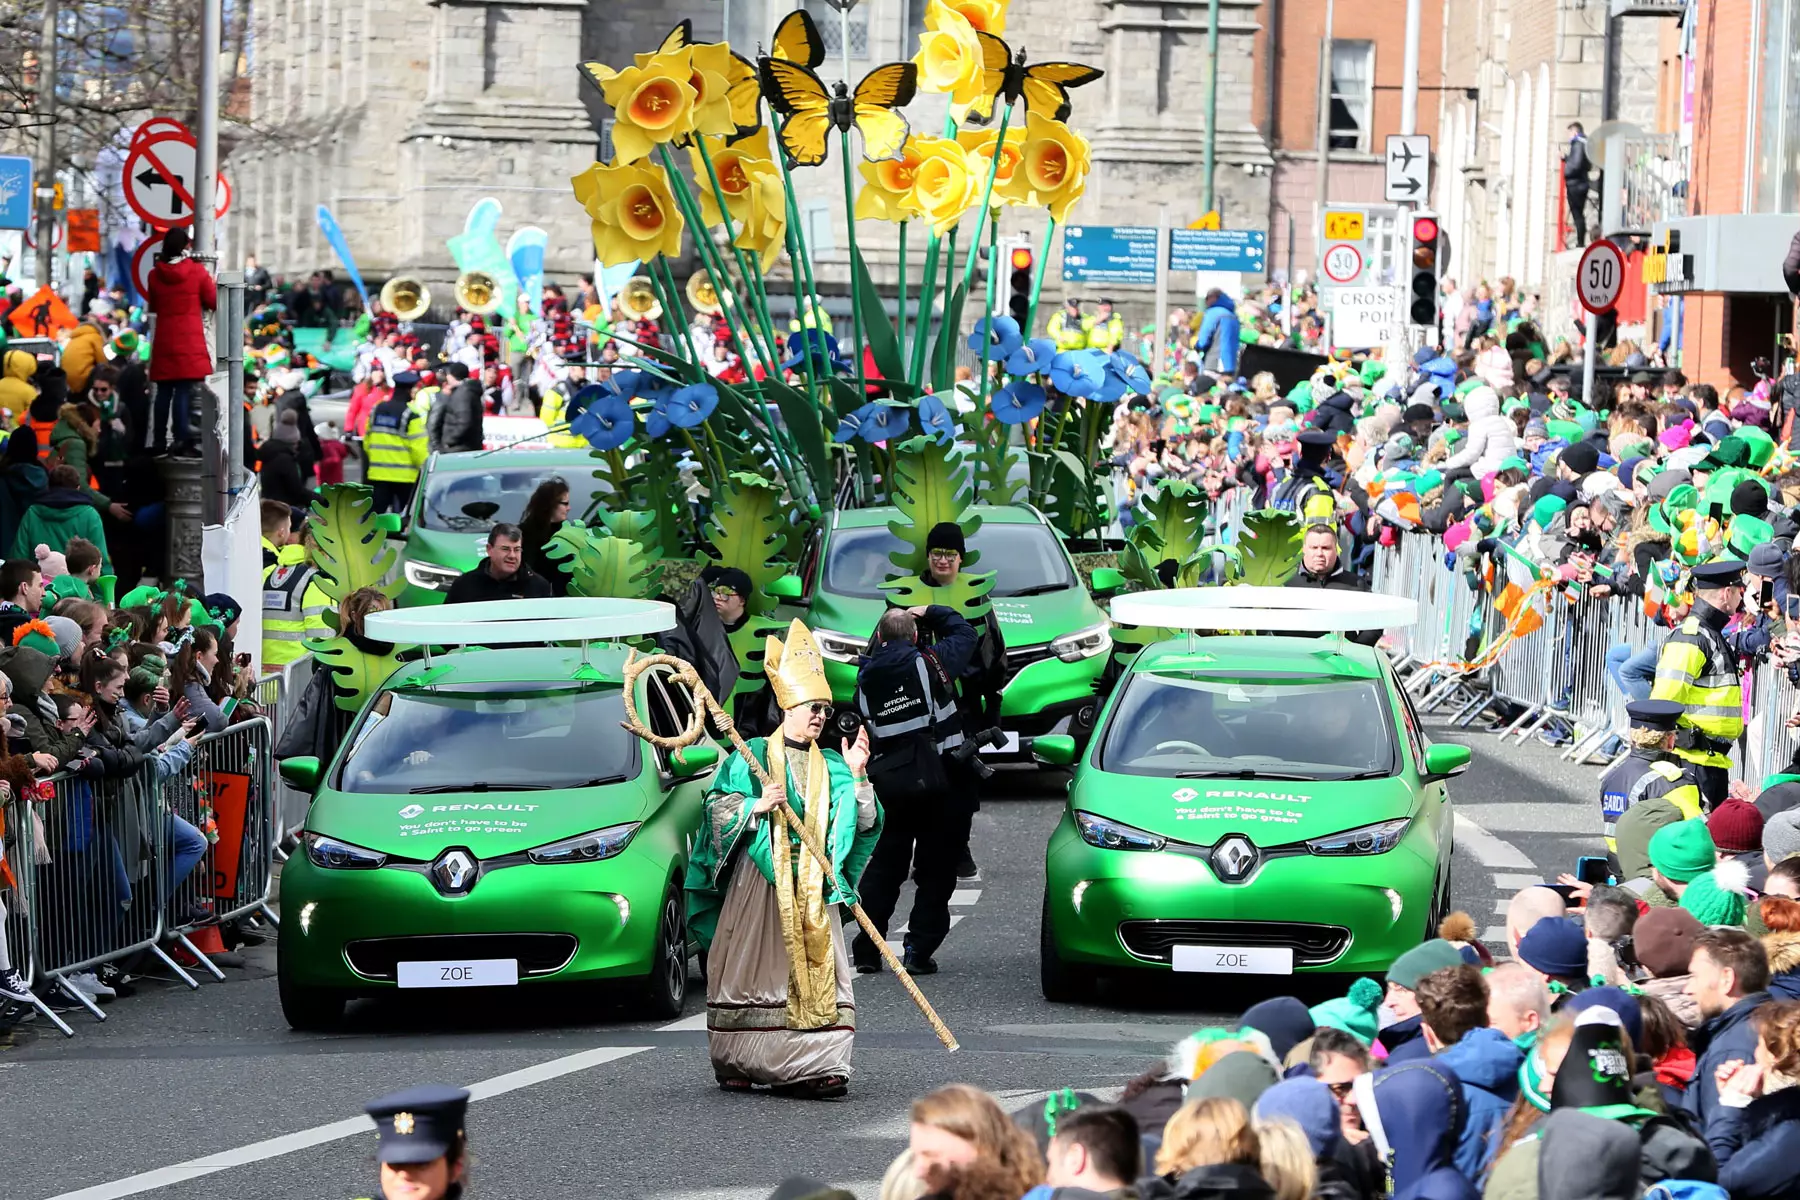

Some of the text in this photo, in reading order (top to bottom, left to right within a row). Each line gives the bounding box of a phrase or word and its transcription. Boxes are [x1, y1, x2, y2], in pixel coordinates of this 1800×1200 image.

[1334, 253, 1353, 269] 30
[1590, 260, 1612, 289] 50
[1341, 293, 1394, 305] CROSS
[1590, 294, 1608, 303] km/h
[1360, 311, 1393, 323] POI
[884, 696, 910, 708] OFFICIAL
[1206, 790, 1312, 803] RENAULT
[432, 804, 540, 812] RENAULT
[1236, 806, 1266, 814] have
[1260, 815, 1298, 824] green
[412, 827, 444, 836] Saint
[1216, 954, 1248, 967] ZOE
[440, 966, 473, 980] ZOE
